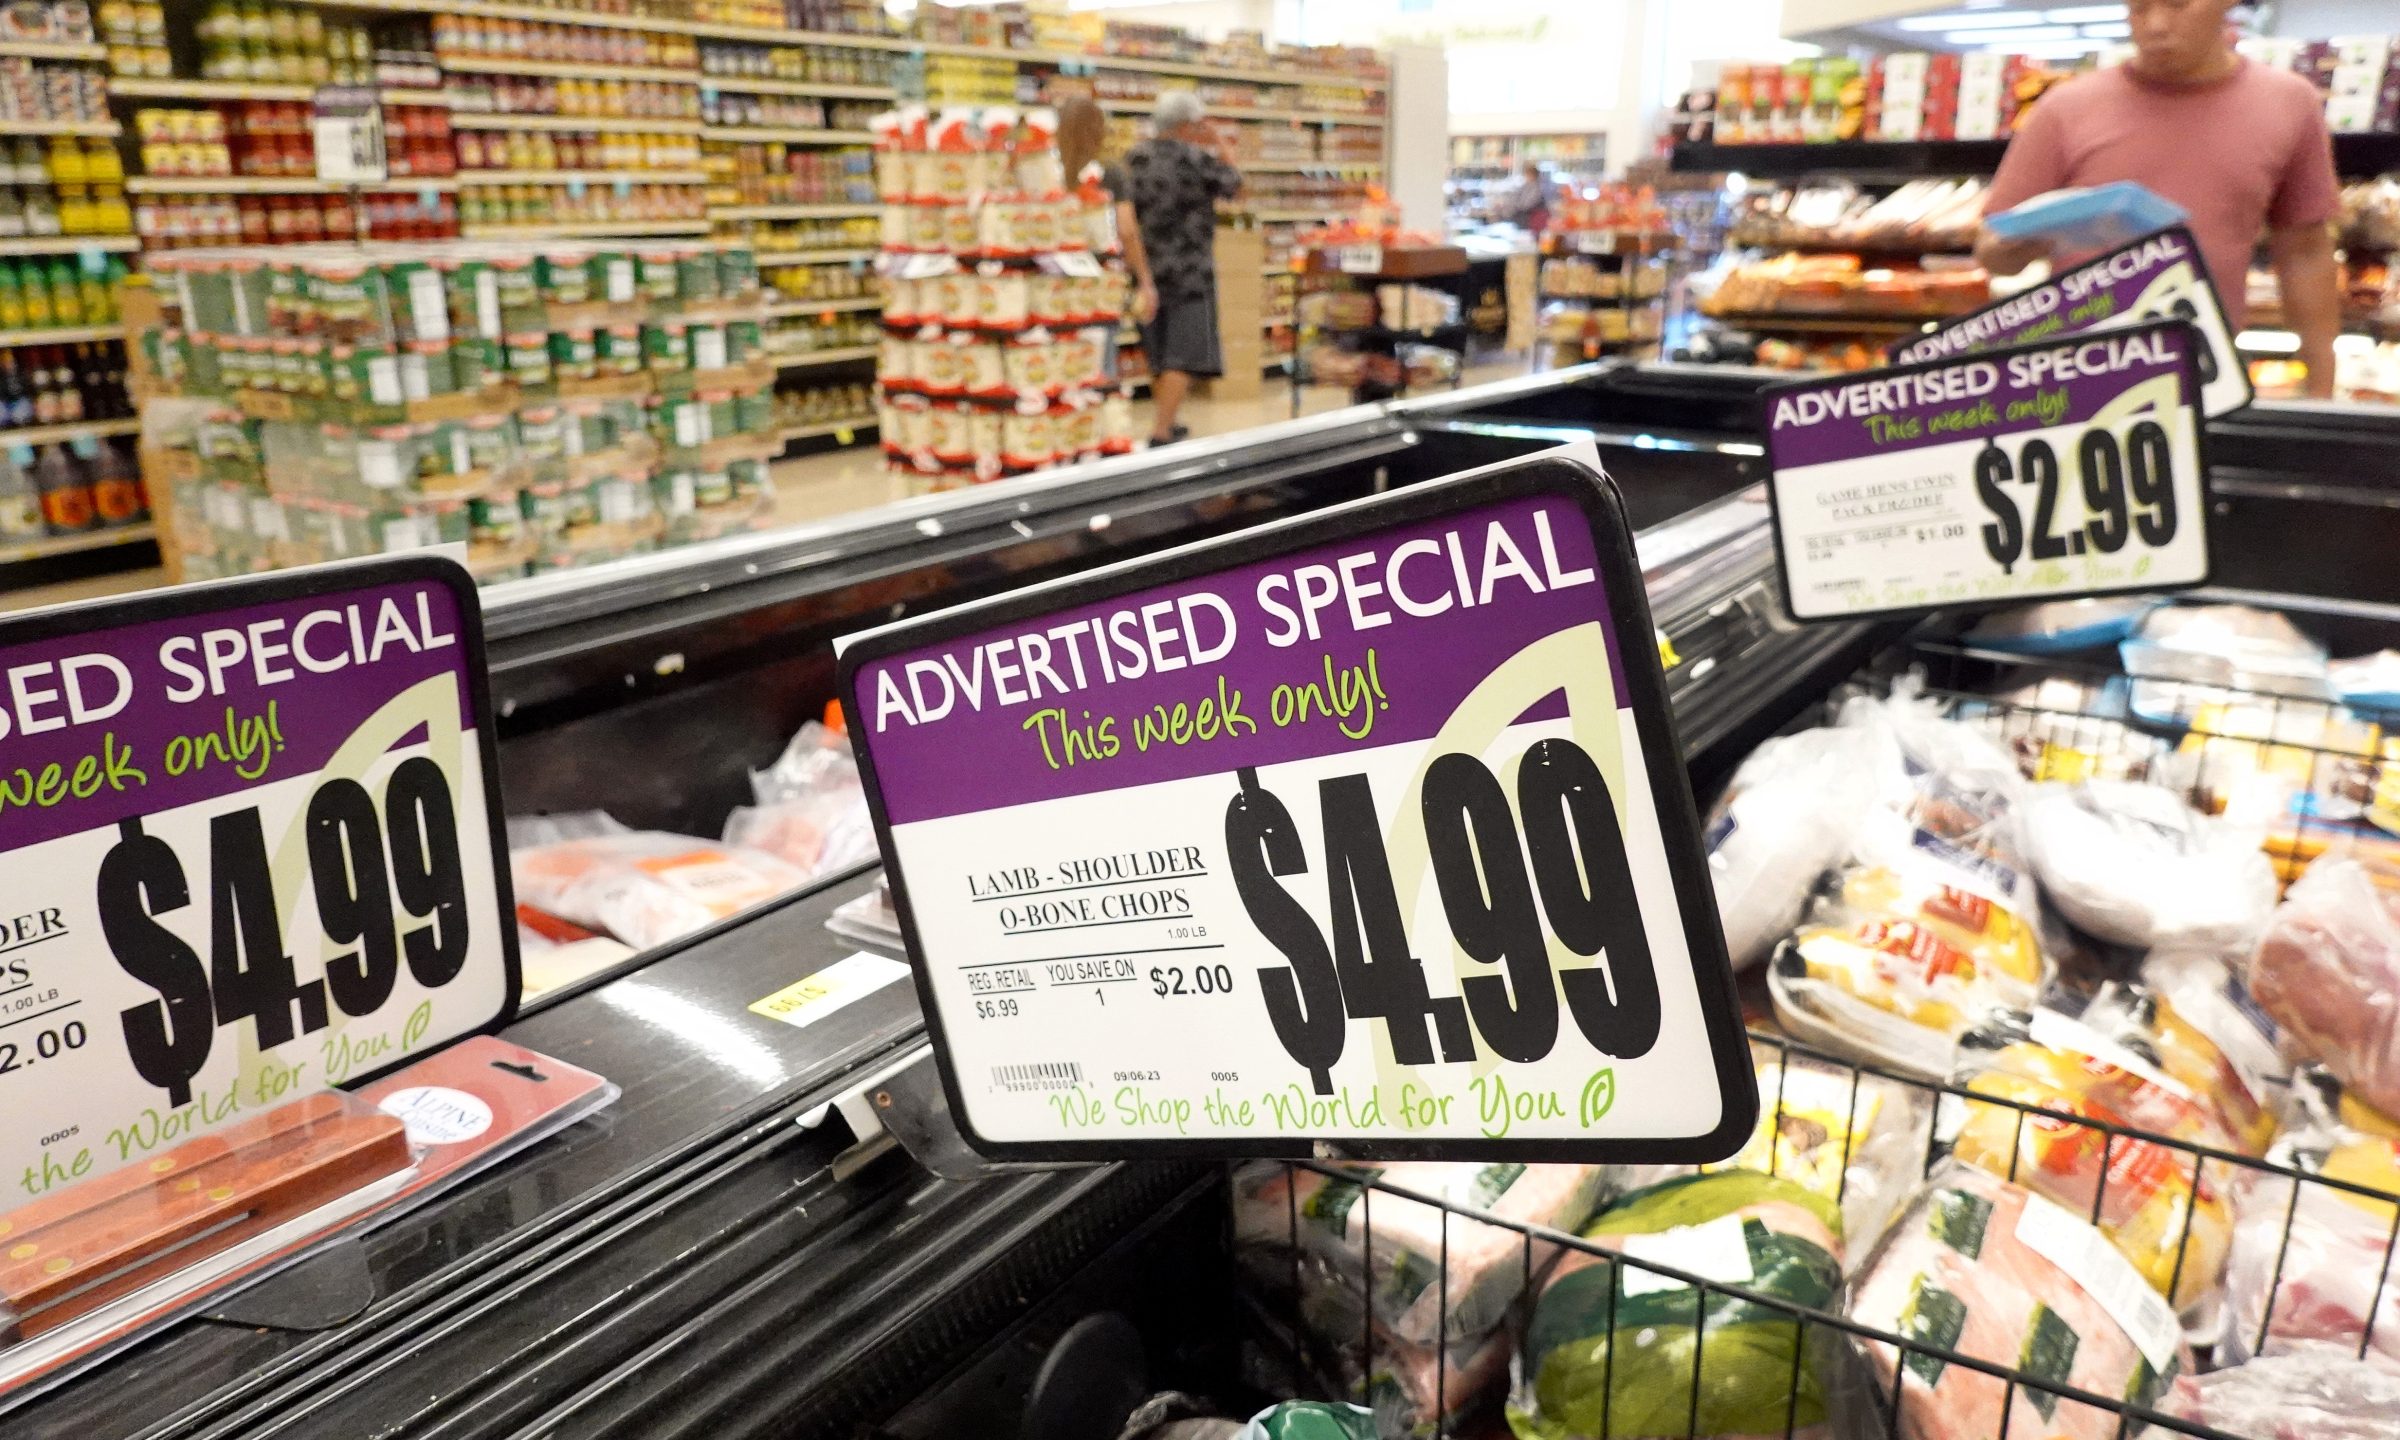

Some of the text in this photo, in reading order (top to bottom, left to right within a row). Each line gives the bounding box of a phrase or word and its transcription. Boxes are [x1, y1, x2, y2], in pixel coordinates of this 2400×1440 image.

[2061, 234, 2187, 302] SPECIAL
[1772, 331, 2181, 430] ADVERTISED SPECIAL
[1863, 386, 2071, 445] This week only!
[1973, 420, 2179, 575] $2.99
[876, 509, 1596, 733] ADVERTISED SPECIAL
[0, 591, 456, 742] ED SPECIAL
[1022, 648, 1390, 770] This week only!
[165, 699, 286, 780] only!
[967, 866, 1040, 898] LAMB
[1058, 845, 1206, 885] SHOULDER
[96, 755, 470, 1108] $4.99
[999, 887, 1191, 930] O-BONE CHOPS
[1167, 926, 1207, 940] 1.00 LB
[1223, 737, 1662, 1096] $4.99
[0, 958, 31, 986] S
[967, 967, 1036, 992] REG. RETAIL
[1045, 958, 1136, 983] YOU SAVE ON
[1095, 987, 1105, 1006] 1
[1149, 964, 1233, 1000] $2.00
[2, 987, 60, 1015] 1.00 LB
[975, 998, 1020, 1020] $6.99
[1210, 1070, 1239, 1083] 0005
[20, 1030, 392, 1196] the World for You
[1049, 1074, 1566, 1139] We Shop the World for You
[40, 1125, 81, 1147] 0005
